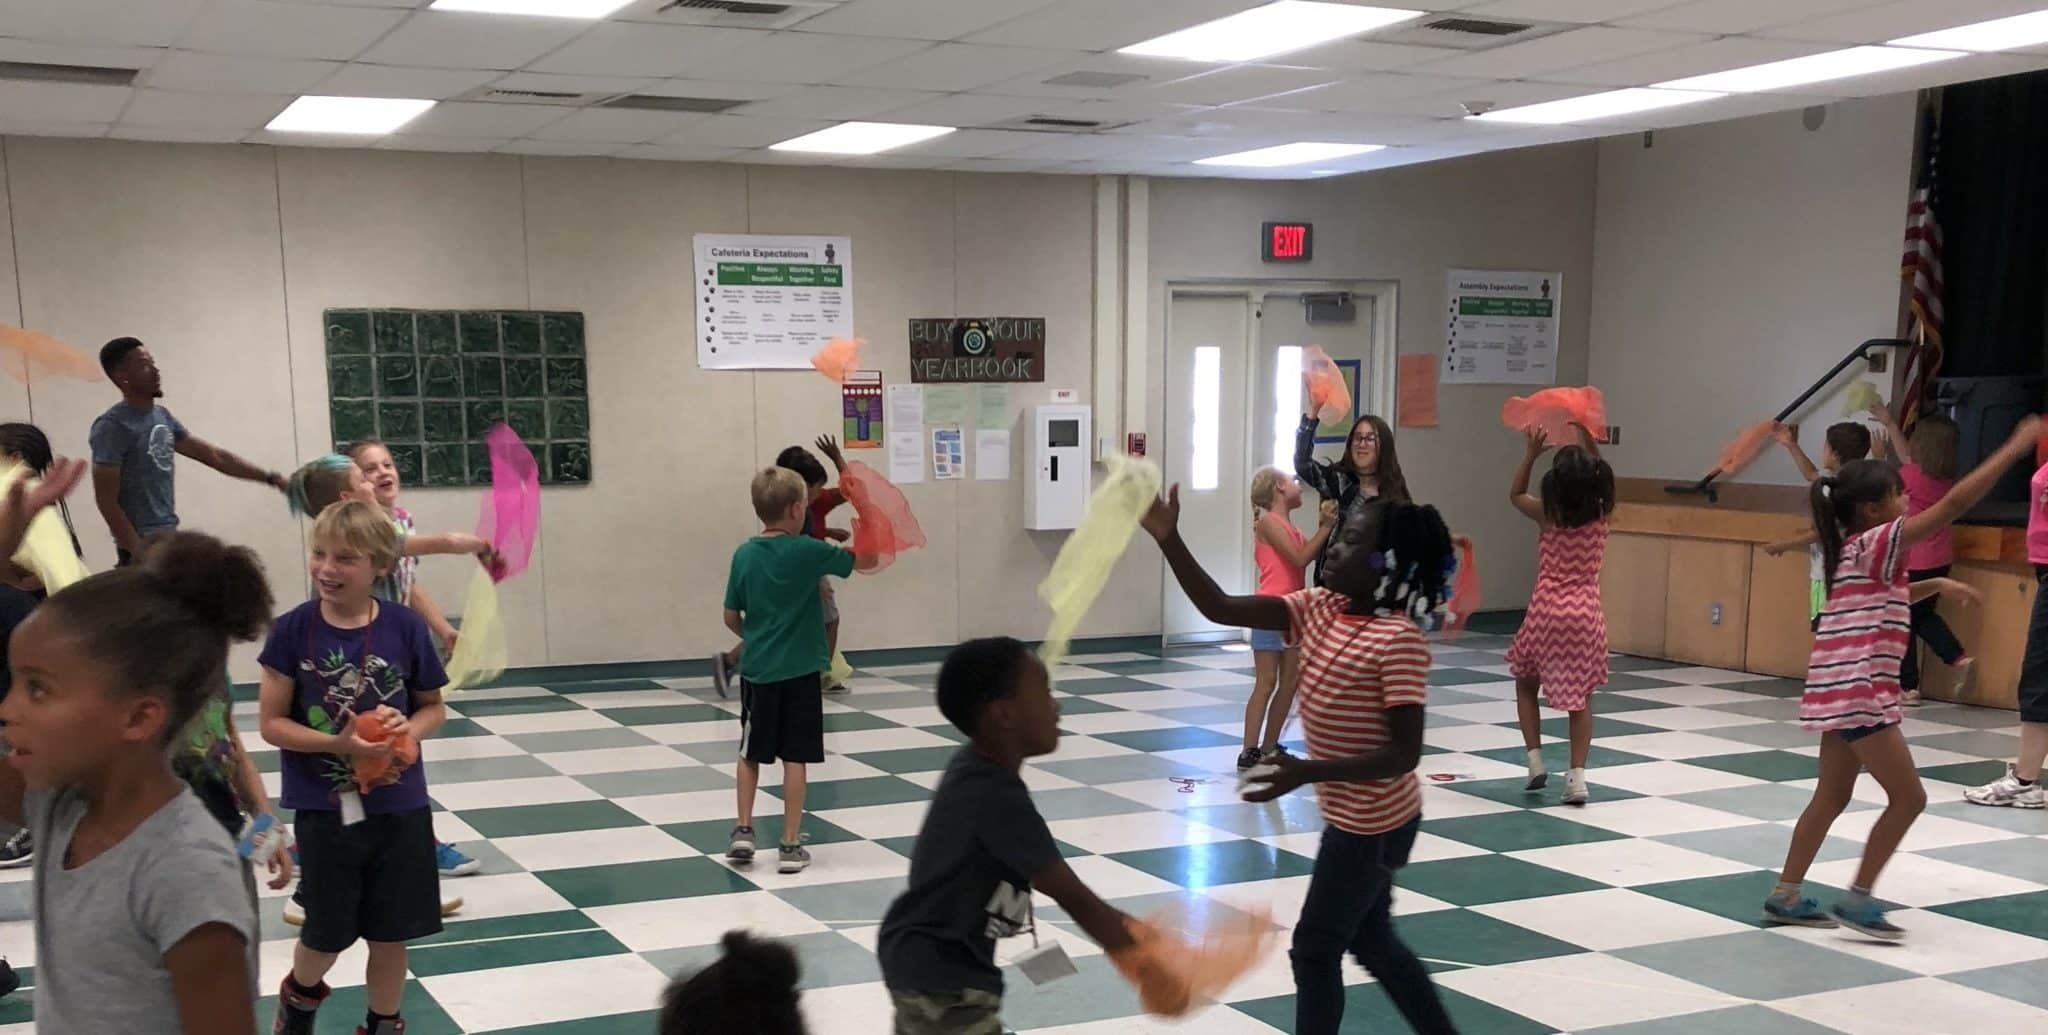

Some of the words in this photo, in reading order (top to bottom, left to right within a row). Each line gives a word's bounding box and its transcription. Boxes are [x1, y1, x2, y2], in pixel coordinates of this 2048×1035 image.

[1273, 225, 1305, 256] EXIT
[711, 247, 751, 258] Cafeteria
[752, 248, 809, 259] Expectations
[1459, 282, 1488, 292] Assembly
[1489, 283, 1528, 292] Expectations
[910, 320, 954, 342] BUY
[986, 318, 1041, 342] YOUR
[911, 358, 1033, 380] YEARBOOK
